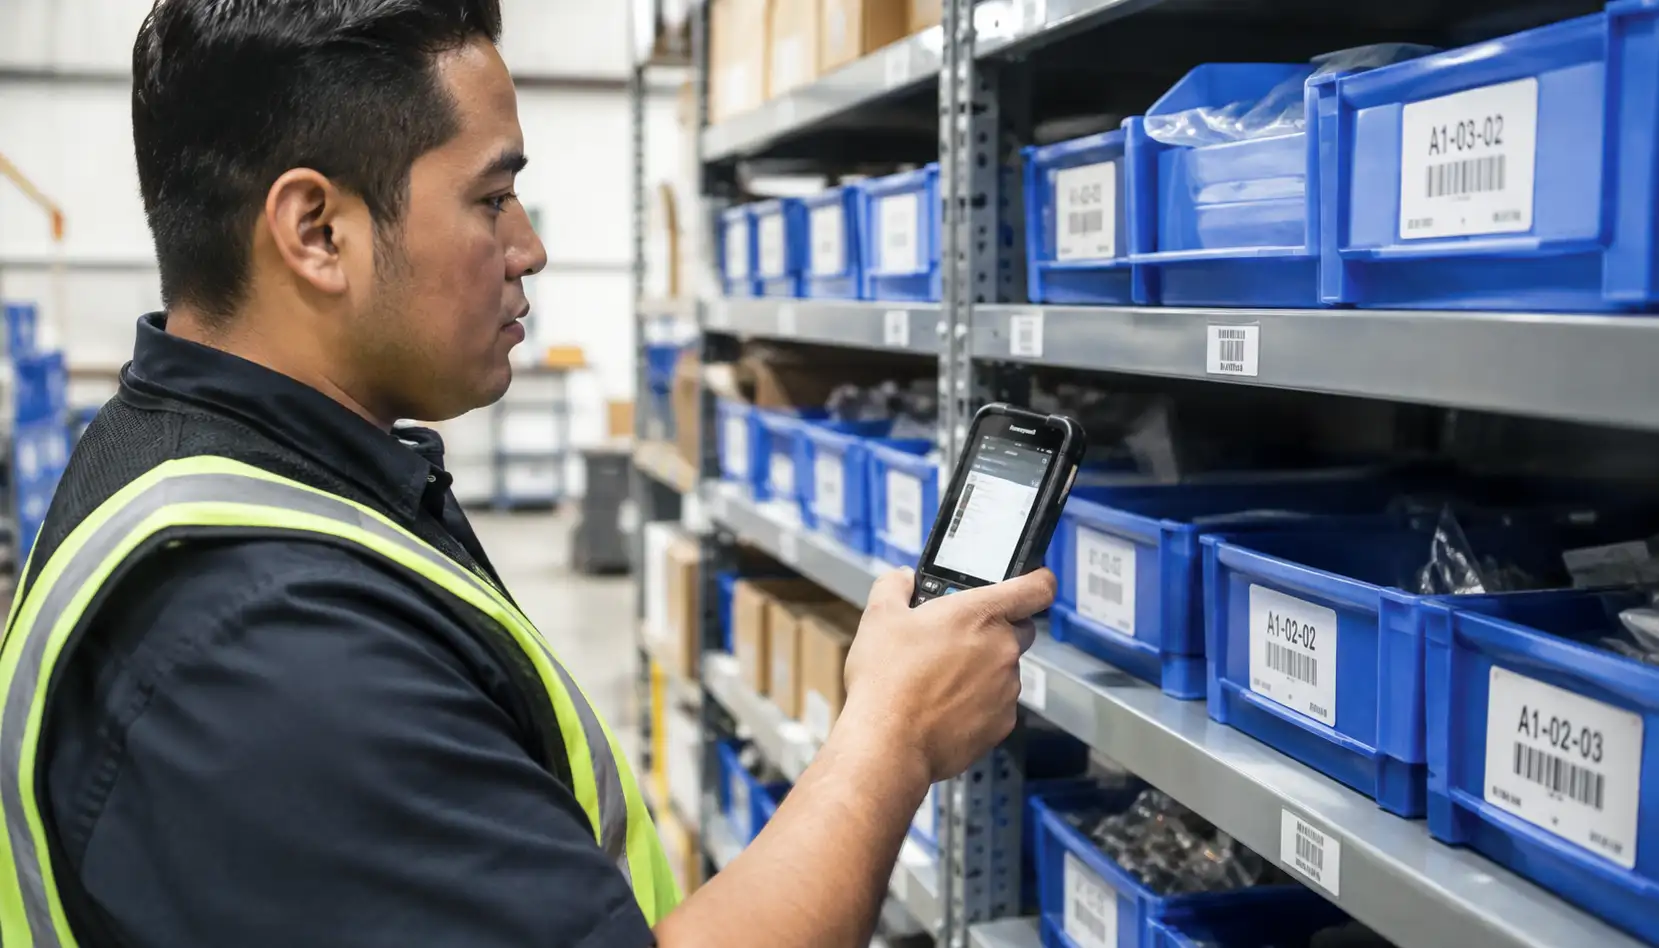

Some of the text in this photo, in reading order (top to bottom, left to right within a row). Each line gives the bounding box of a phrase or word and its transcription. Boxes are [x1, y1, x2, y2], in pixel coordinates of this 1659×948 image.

[1428, 114, 1504, 156] A1-03-02
[1266, 610, 1316, 651] A1-02-02
[1517, 705, 1604, 763] A1-02-03
